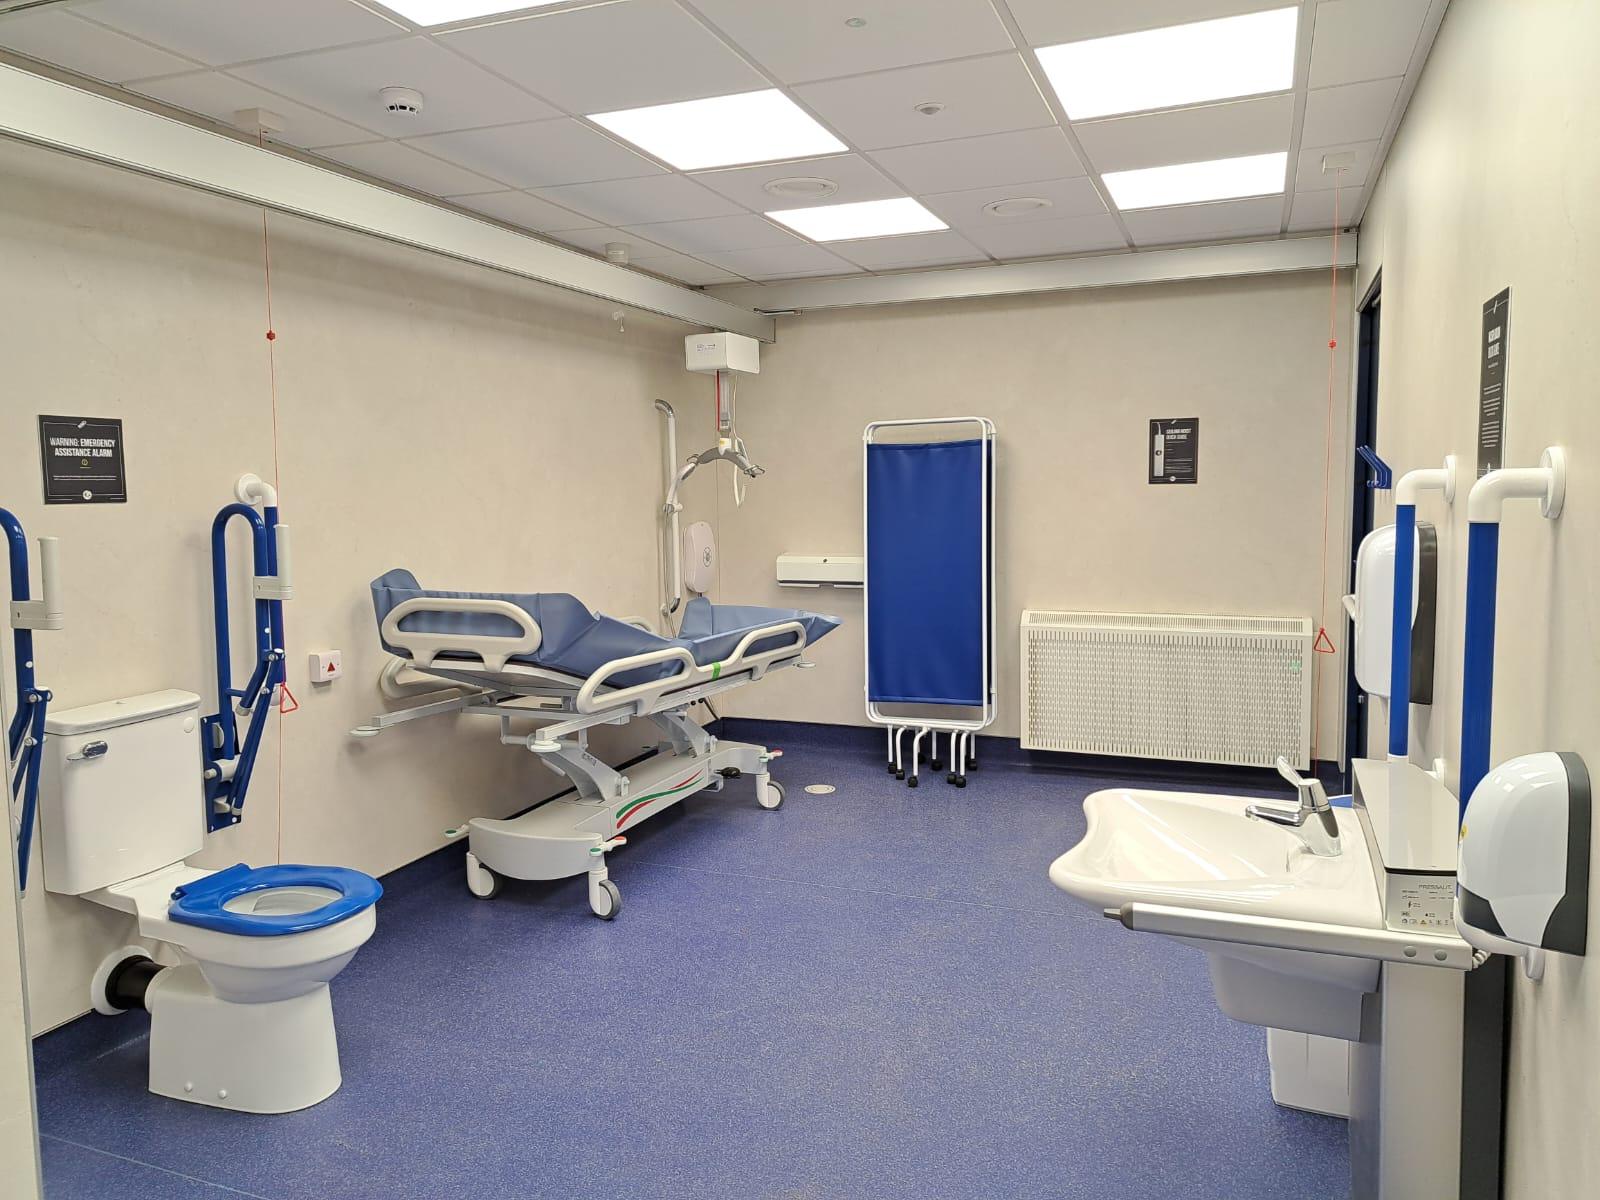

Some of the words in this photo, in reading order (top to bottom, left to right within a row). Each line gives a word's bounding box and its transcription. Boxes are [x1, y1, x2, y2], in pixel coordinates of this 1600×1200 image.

[50, 437, 79, 447] WARNING:
[80, 438, 115, 448] EMERGENCY
[54, 448, 91, 457] ASSISTANCE
[92, 449, 113, 457] ALARM
